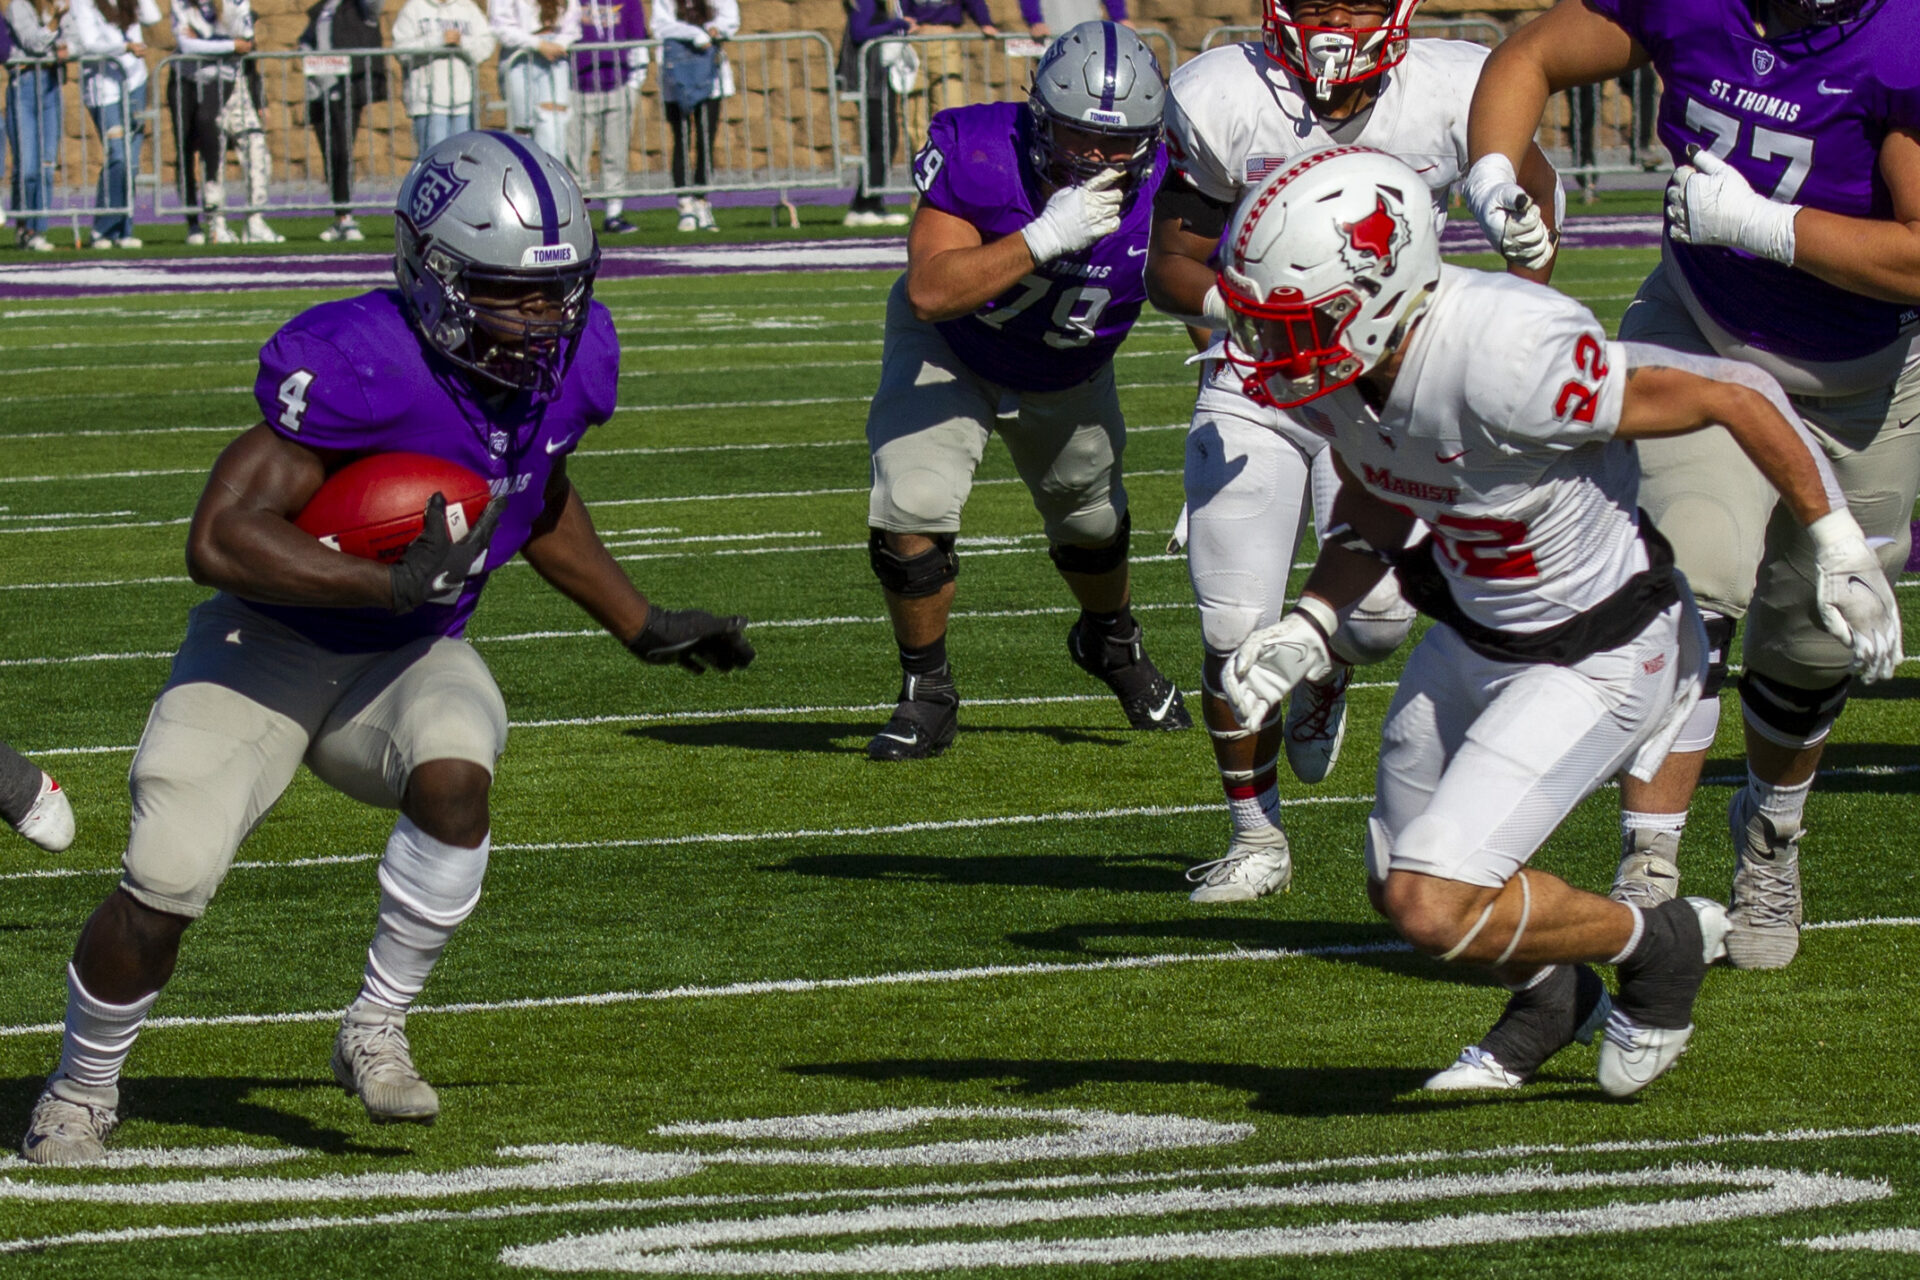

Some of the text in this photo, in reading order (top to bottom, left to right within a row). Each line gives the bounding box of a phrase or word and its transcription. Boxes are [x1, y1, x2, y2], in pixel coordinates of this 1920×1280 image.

[1089, 111, 1121, 125] TOMMIES
[1709, 79, 1801, 122] ST. THOMAS
[1685, 97, 1815, 204] 77
[533, 247, 571, 263] TOMMIES
[974, 273, 1112, 349] 79
[277, 368, 315, 433] 4
[1551, 331, 1609, 428] 22
